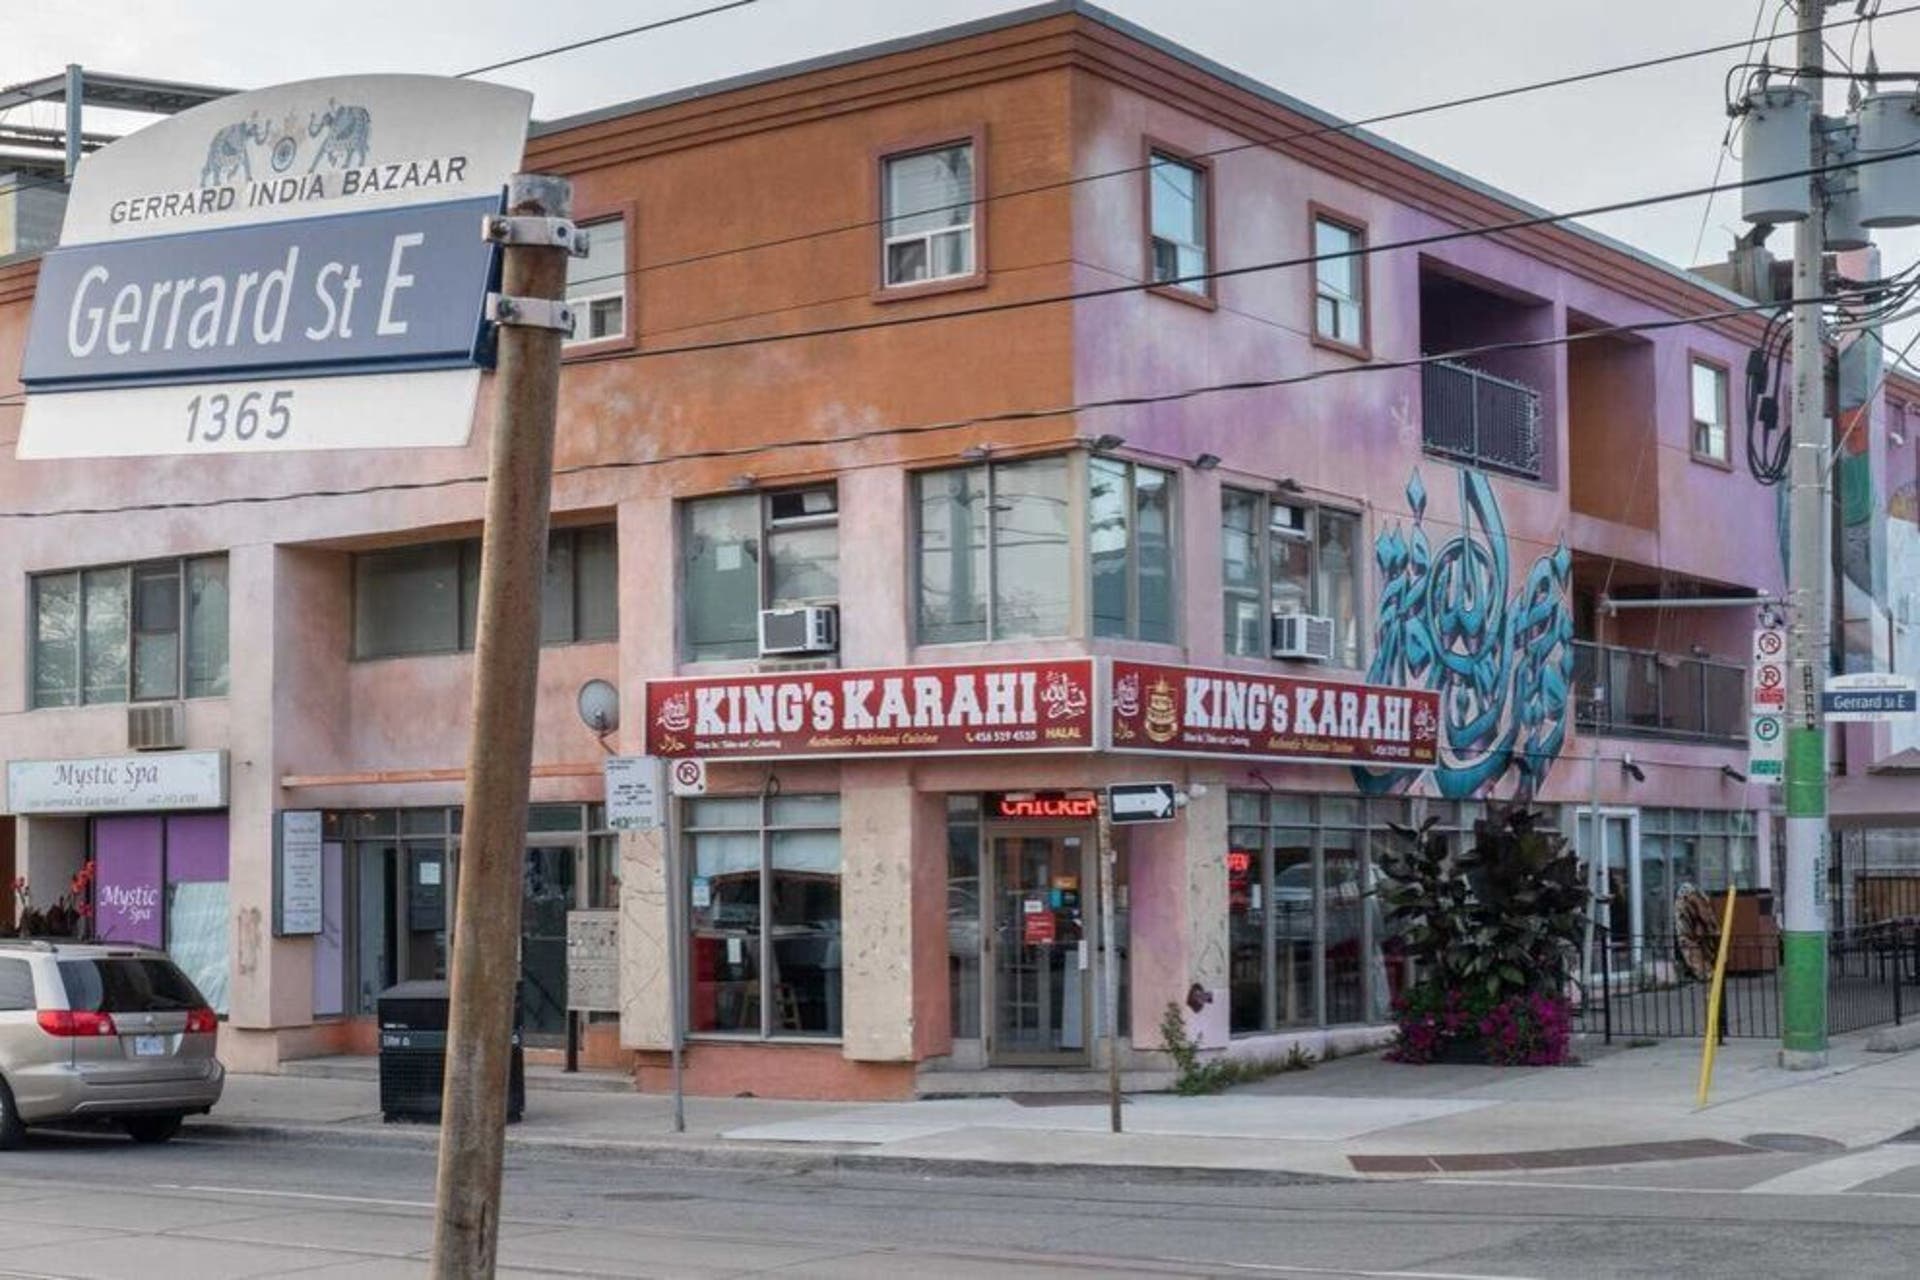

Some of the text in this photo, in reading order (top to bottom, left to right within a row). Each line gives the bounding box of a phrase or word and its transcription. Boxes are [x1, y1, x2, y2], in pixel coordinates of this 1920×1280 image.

[110, 156, 467, 224] GERRARD INDIA BAZAAR
[68, 232, 424, 358] Gerrard St E
[186, 390, 294, 442] 1365
[695, 683, 834, 735] KING's
[842, 672, 1037, 730] KARAHI
[1183, 676, 1288, 733] KING's
[1294, 687, 1412, 742] KARAHI
[1833, 694, 1882, 709] Gerrard
[1898, 694, 1905, 708] E
[1045, 726, 1082, 739] HALAL
[53, 760, 159, 793] Mystic Spa
[100, 884, 158, 914] Mystic
[129, 905, 152, 925] Spa
